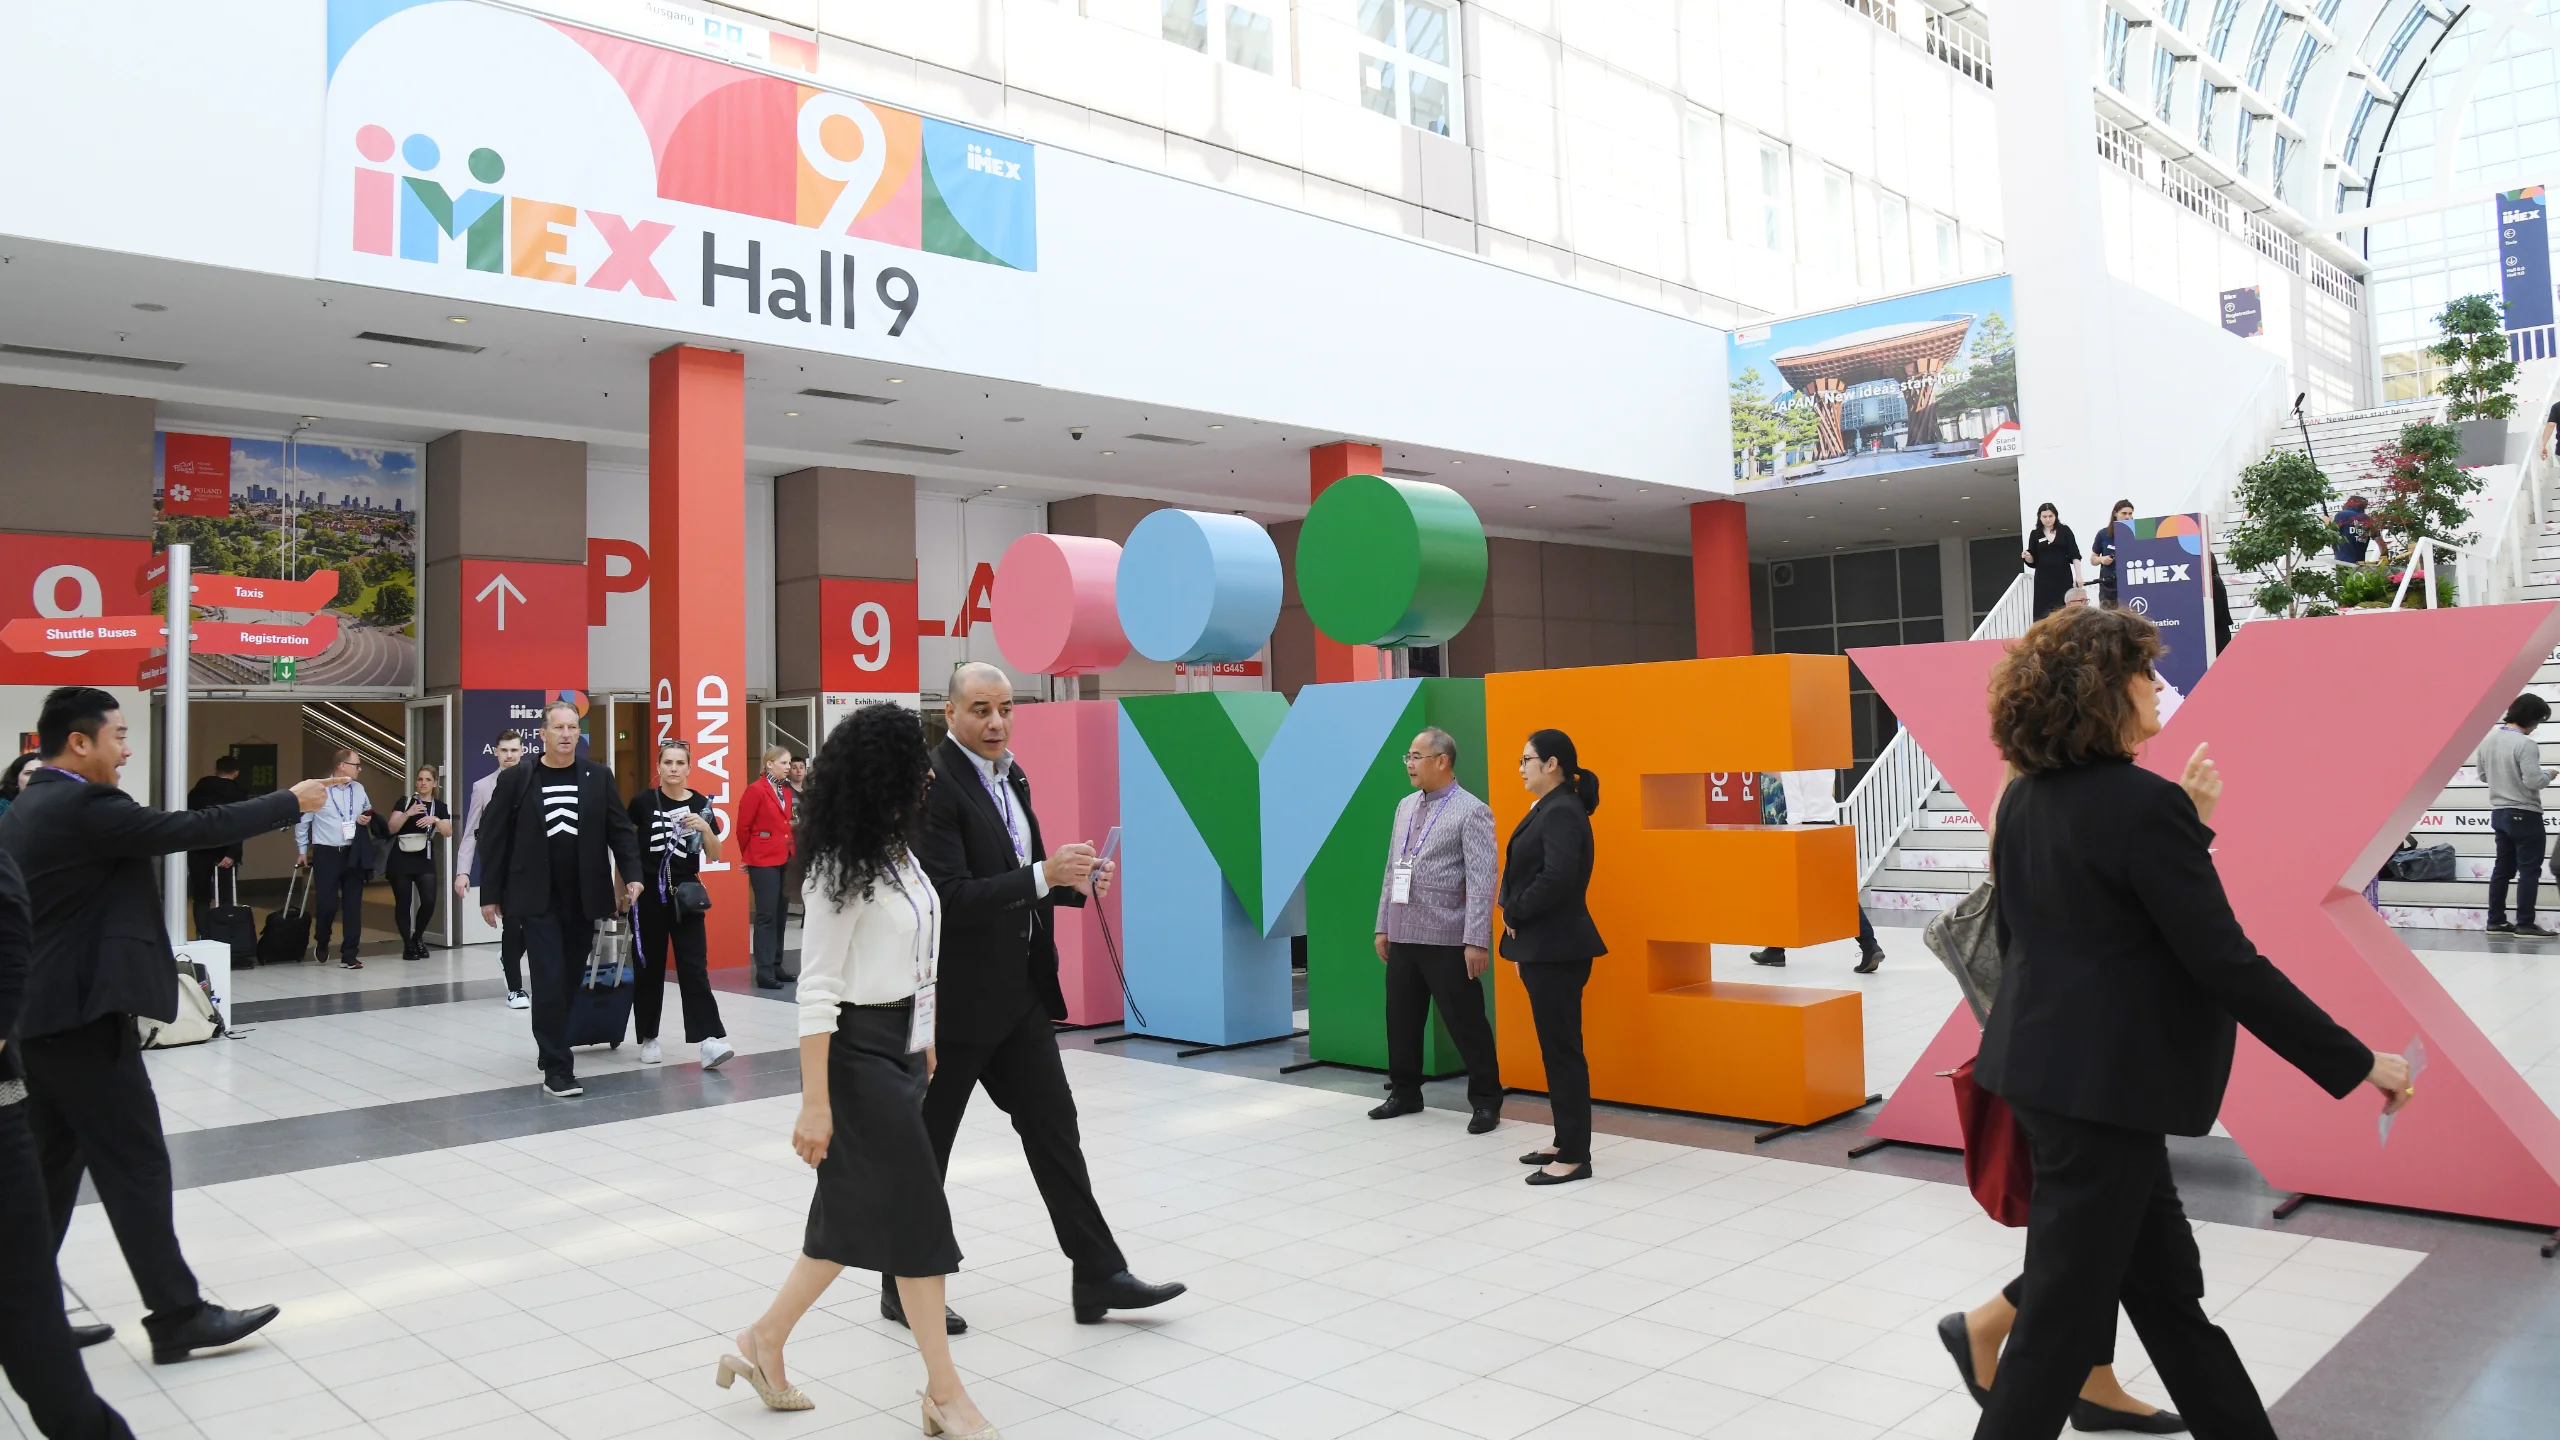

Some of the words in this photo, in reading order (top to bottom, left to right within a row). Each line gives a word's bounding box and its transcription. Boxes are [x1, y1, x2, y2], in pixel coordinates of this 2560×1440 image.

[797, 91, 886, 235] 9
[702, 230, 855, 330] Hall
[876, 266, 919, 338] 9
[1824, 388, 1855, 404] New
[1859, 383, 1896, 398] ideas
[1900, 375, 1935, 392] start
[1937, 370, 1971, 386] here
[1996, 437, 2016, 445] Stand
[1996, 444, 2017, 452] B430
[235, 586, 264, 599] Taxis
[33, 565, 103, 658] 9
[46, 628, 95, 640] Shuttle
[98, 627, 137, 639] Buses
[240, 632, 309, 646] Registration
[851, 602, 891, 672] 9
[1223, 663, 1245, 673] G445
[1941, 815, 1977, 824] JAPAN
[2455, 815, 2490, 826] New
